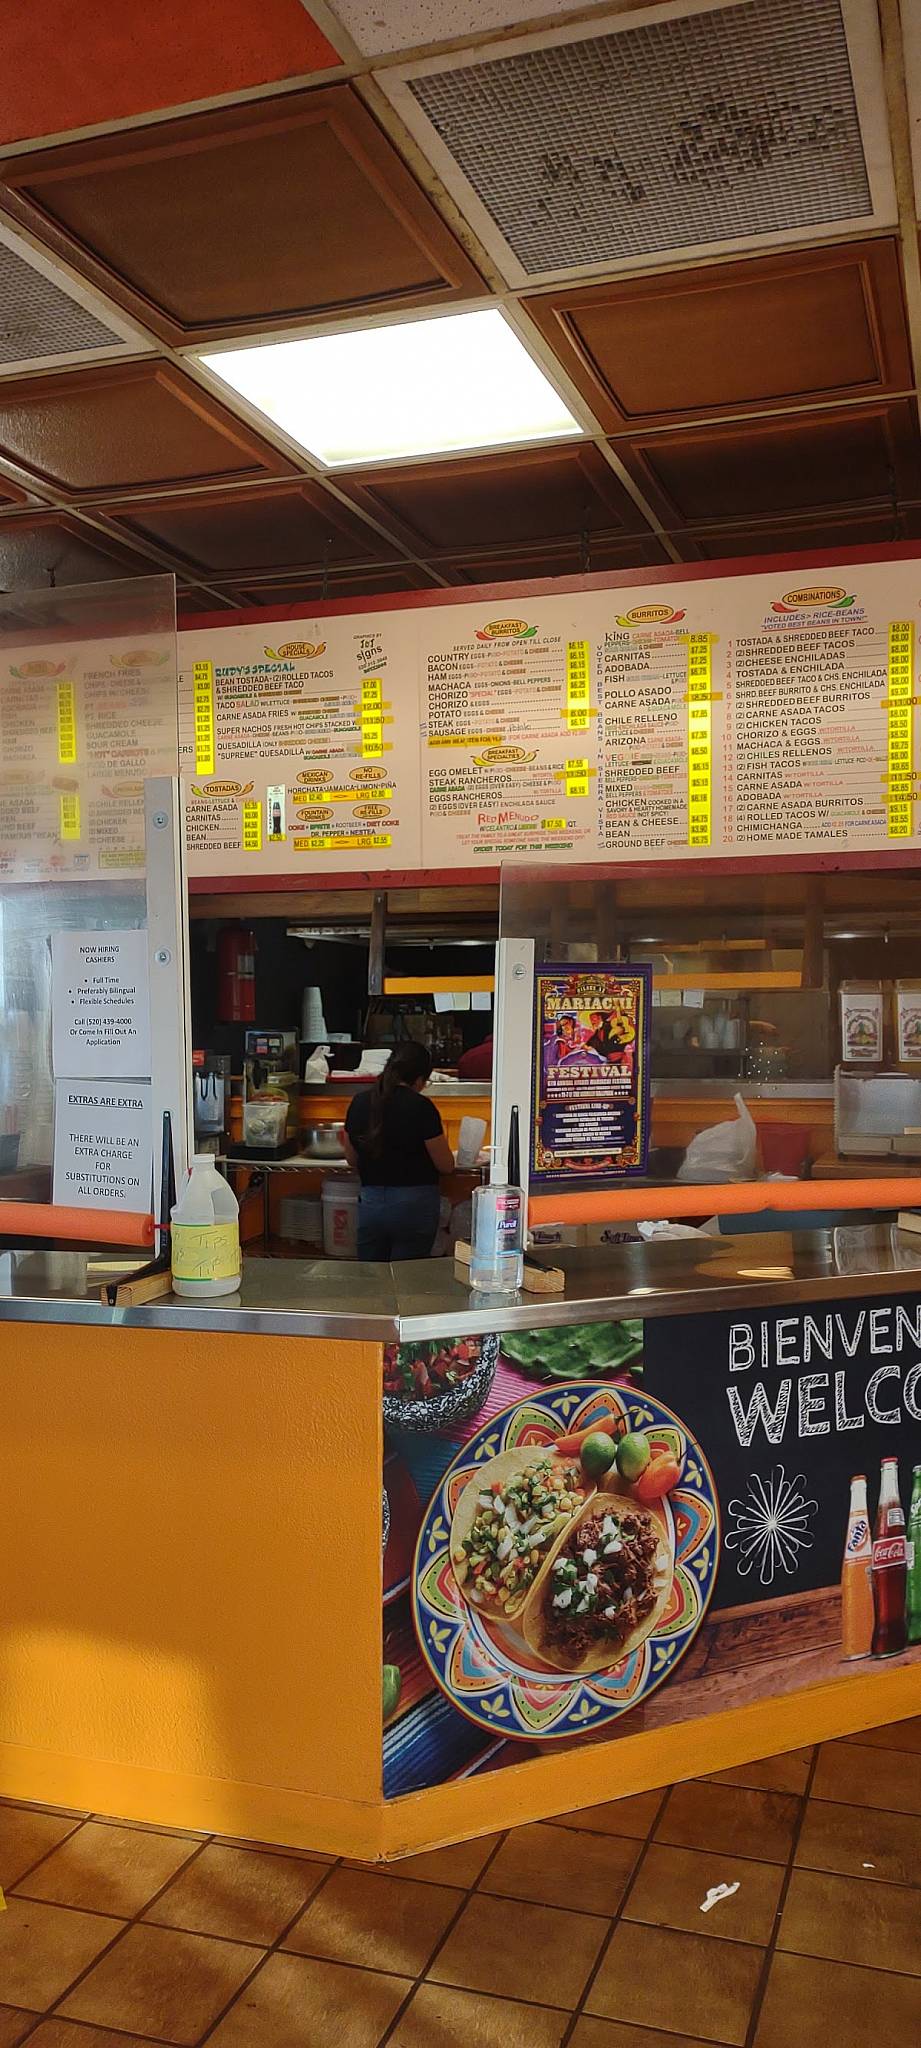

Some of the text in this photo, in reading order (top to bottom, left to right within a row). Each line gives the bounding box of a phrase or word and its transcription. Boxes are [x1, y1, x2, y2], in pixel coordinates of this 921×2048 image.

[787, 591, 841, 603] COMBINATIONS
[632, 610, 668, 618] BURRITOS
[736, 628, 874, 647] TOSTADA SHREDDED BEEF TACO
[797, 640, 855, 651] BEEF TACOS
[428, 653, 469, 663] COUNTRY
[605, 652, 651, 662] CARNITAS
[785, 652, 845, 663] ENCHILADAS
[428, 663, 458, 672] BACON
[605, 663, 649, 673] ADOBADA
[736, 663, 844, 678] TOSTADA ENCHILADA
[216, 678, 234, 686] BEAN
[428, 673, 446, 681] HAM
[605, 675, 625, 683] FISH
[736, 669, 887, 688] SHREDDED BEEF TACO ENCHILADA
[264, 682, 282, 690] BEEF
[429, 682, 471, 691] MACHACA
[758, 680, 885, 697] BEEF BURRITO ENCHILADA
[429, 691, 468, 700] CHORIZO
[605, 687, 671, 699] POLLO ASADO
[797, 692, 870, 704] BEEF BURRITOS
[216, 702, 235, 710] TACO
[429, 700, 468, 710] CHORIZO
[605, 698, 671, 709] CARNE ASADA
[217, 713, 241, 721] CARNE
[429, 710, 461, 719] POTATO
[746, 705, 845, 719] CARNE ASADA TACOS
[429, 720, 453, 728] STEAK
[605, 713, 677, 725] CHILE RELLENO
[746, 717, 822, 729] CHICKEN TACOS
[242, 725, 272, 734] NACHOS
[429, 728, 466, 736] SAUSAGE
[737, 728, 816, 740] CHORIZO EGGS
[218, 741, 261, 750] QUESADILLA
[605, 737, 646, 746] ARIZONA
[737, 738, 820, 750] MACHACA EGGS
[260, 748, 304, 757] QUESADILLA
[747, 748, 832, 760] CHILES RELLENOS
[770, 760, 800, 768] TACOS
[429, 767, 482, 777] EGG OMELET
[605, 768, 653, 777] SHREDDED
[656, 766, 680, 774] BEEF
[737, 771, 782, 781] CARNITAS
[459, 775, 511, 784] RANCHEROS
[606, 784, 632, 792] MIXED
[737, 781, 802, 791] CARNE ASADA
[429, 792, 502, 802] EGGS RANCHEROS
[737, 792, 781, 801] ADOBADA
[606, 799, 647, 807] CHICKEN
[747, 797, 863, 811] CARNE ASADA BURRITOS
[186, 805, 211, 813] CARNE
[186, 814, 220, 822] CARNITAS
[785, 810, 815, 819] TACOS
[606, 817, 679, 828] BEAN CHEESE
[737, 822, 803, 832] CHIMICHANGA
[606, 830, 630, 838] BEAN
[747, 829, 848, 841] HOME MADE TAMALES
[606, 840, 641, 848] GROUND
[77, 987, 136, 995] Preferably Bilingual
[86, 1018, 101, 1026] (520)
[547, 1066, 631, 1078] FESTIVAL
[68, 1095, 98, 1105] EXTRAS
[118, 1099, 143, 1107] EXTRA
[69, 1134, 93, 1143] THERE
[96, 1135, 115, 1144] WILL
[128, 1138, 139, 1146] AN
[74, 1147, 132, 1159] EXTRA CHARGE
[96, 1162, 110, 1170] FOR
[66, 1172, 139, 1186] SUBSTITUTIONS ON
[78, 1187, 125, 1198] ALL ORDERS.
[848, 1520, 866, 1551] Fanta
